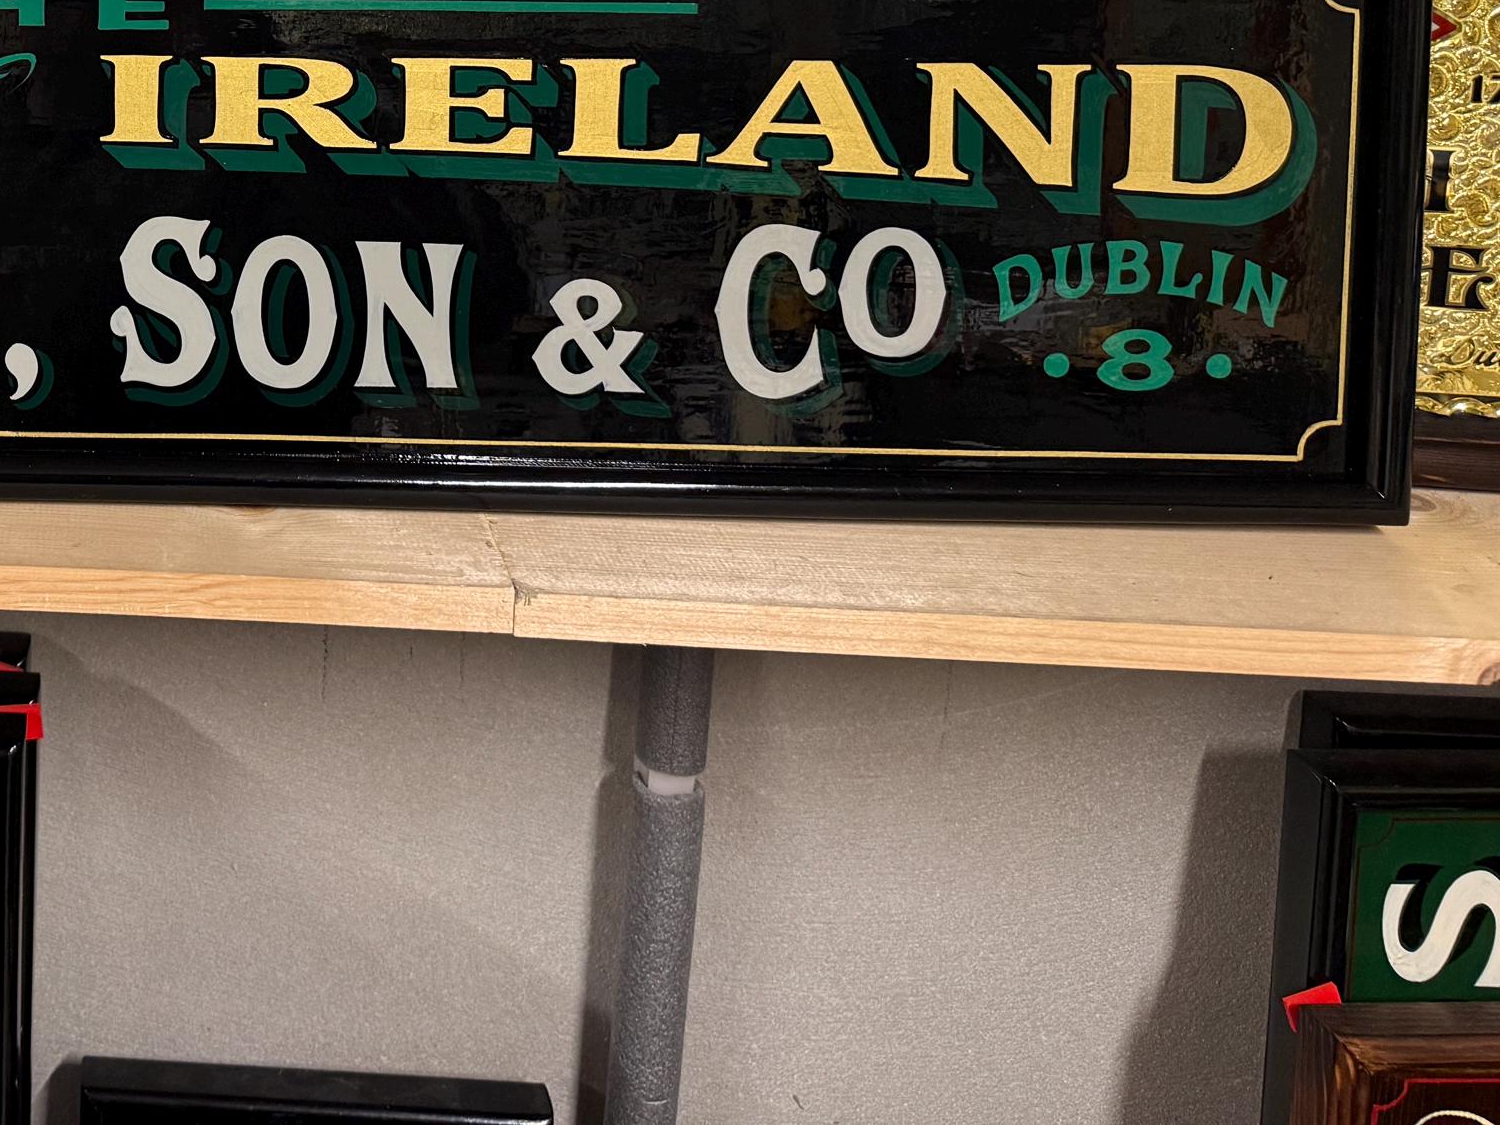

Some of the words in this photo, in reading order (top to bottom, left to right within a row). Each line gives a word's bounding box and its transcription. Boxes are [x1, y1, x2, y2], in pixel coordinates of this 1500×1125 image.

[100, 54, 1293, 196] IRELAND
[110, 215, 465, 389] SON
[531, 278, 646, 395] &
[713, 223, 948, 399] CO
[992, 239, 1288, 327] DUBLIN
[1097, 328, 1175, 391] 8
